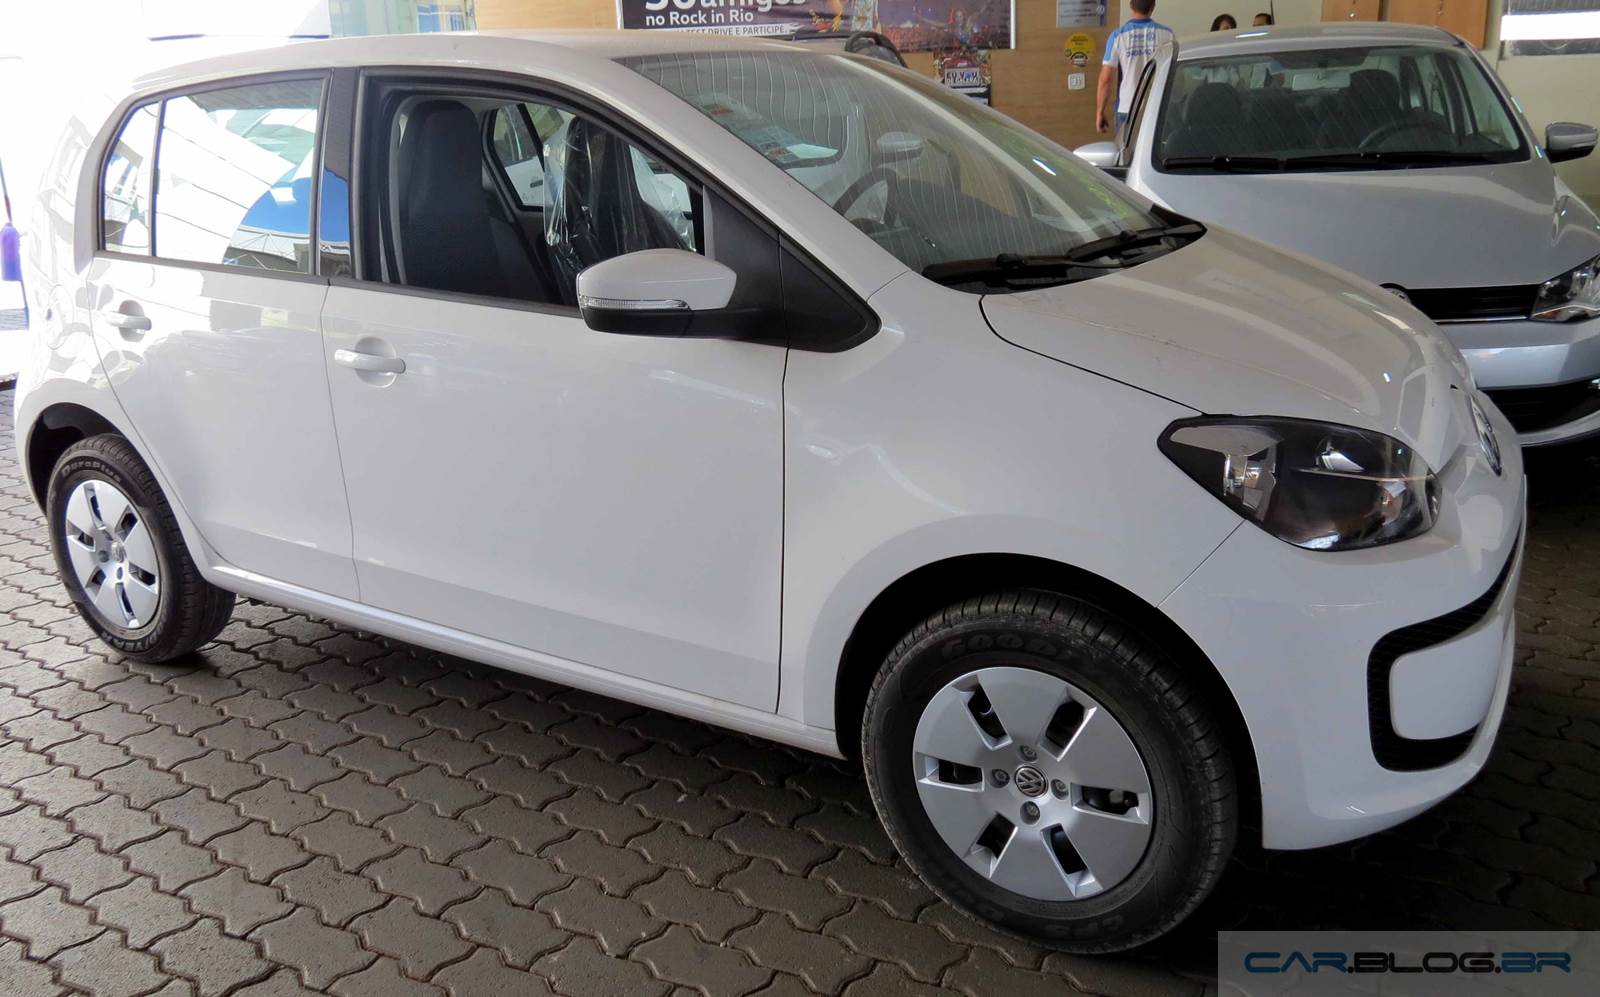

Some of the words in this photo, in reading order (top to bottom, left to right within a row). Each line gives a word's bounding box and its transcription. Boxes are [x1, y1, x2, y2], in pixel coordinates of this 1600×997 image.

[645, 15, 665, 26] no
[669, 10, 707, 25] Rock
[711, 9, 724, 23] in
[729, 9, 754, 23] Rio
